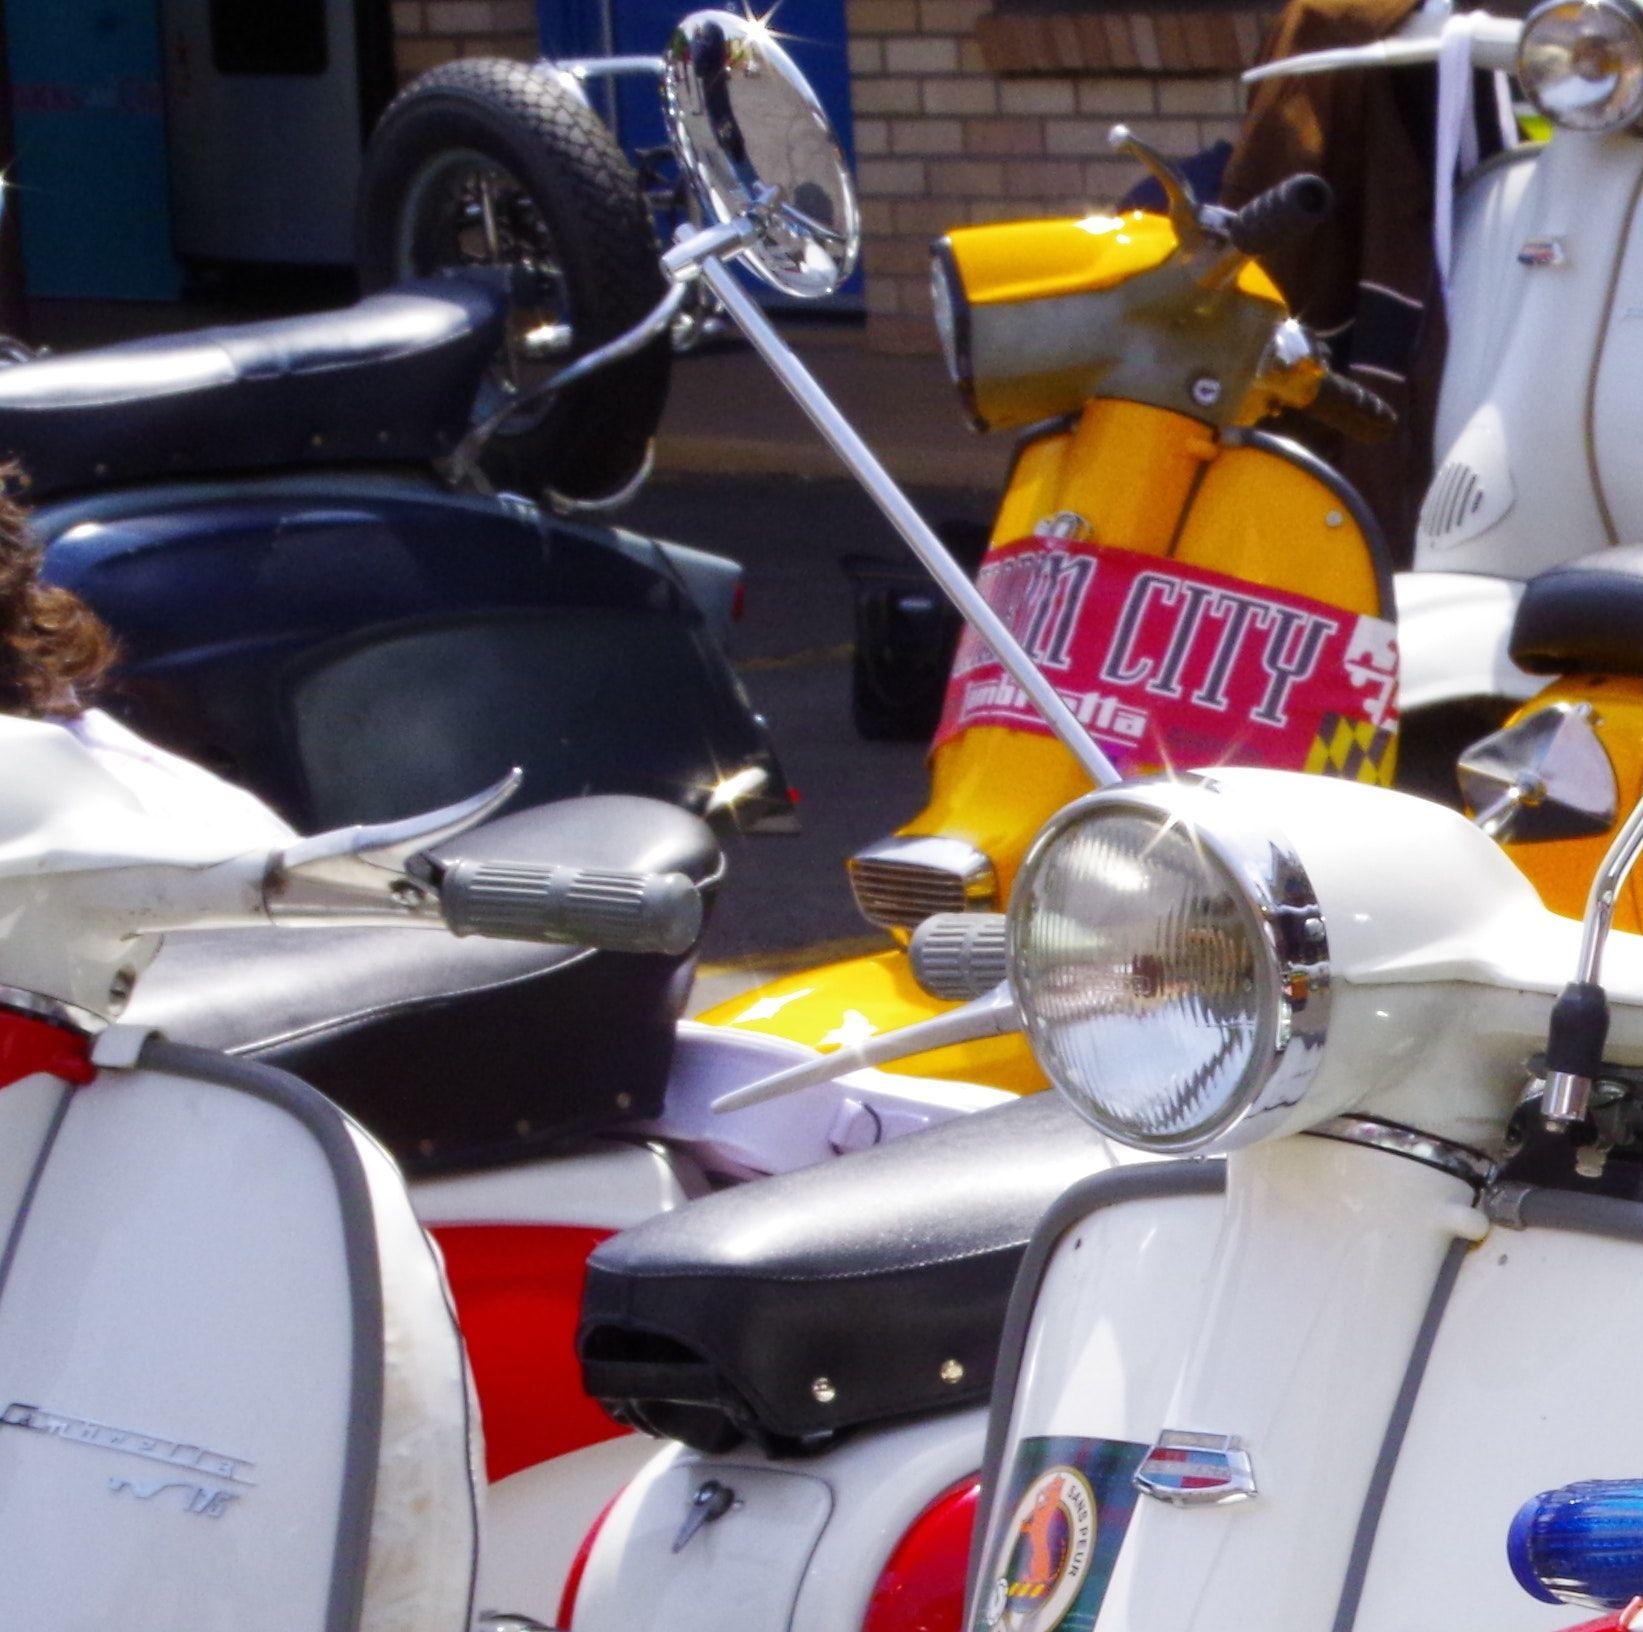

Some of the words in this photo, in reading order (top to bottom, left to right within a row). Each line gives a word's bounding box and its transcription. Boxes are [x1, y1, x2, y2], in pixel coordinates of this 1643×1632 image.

[1101, 568, 1337, 729] CITY
[1067, 1485, 1089, 1527] SANS
[1067, 1527, 1090, 1578] PEUR
